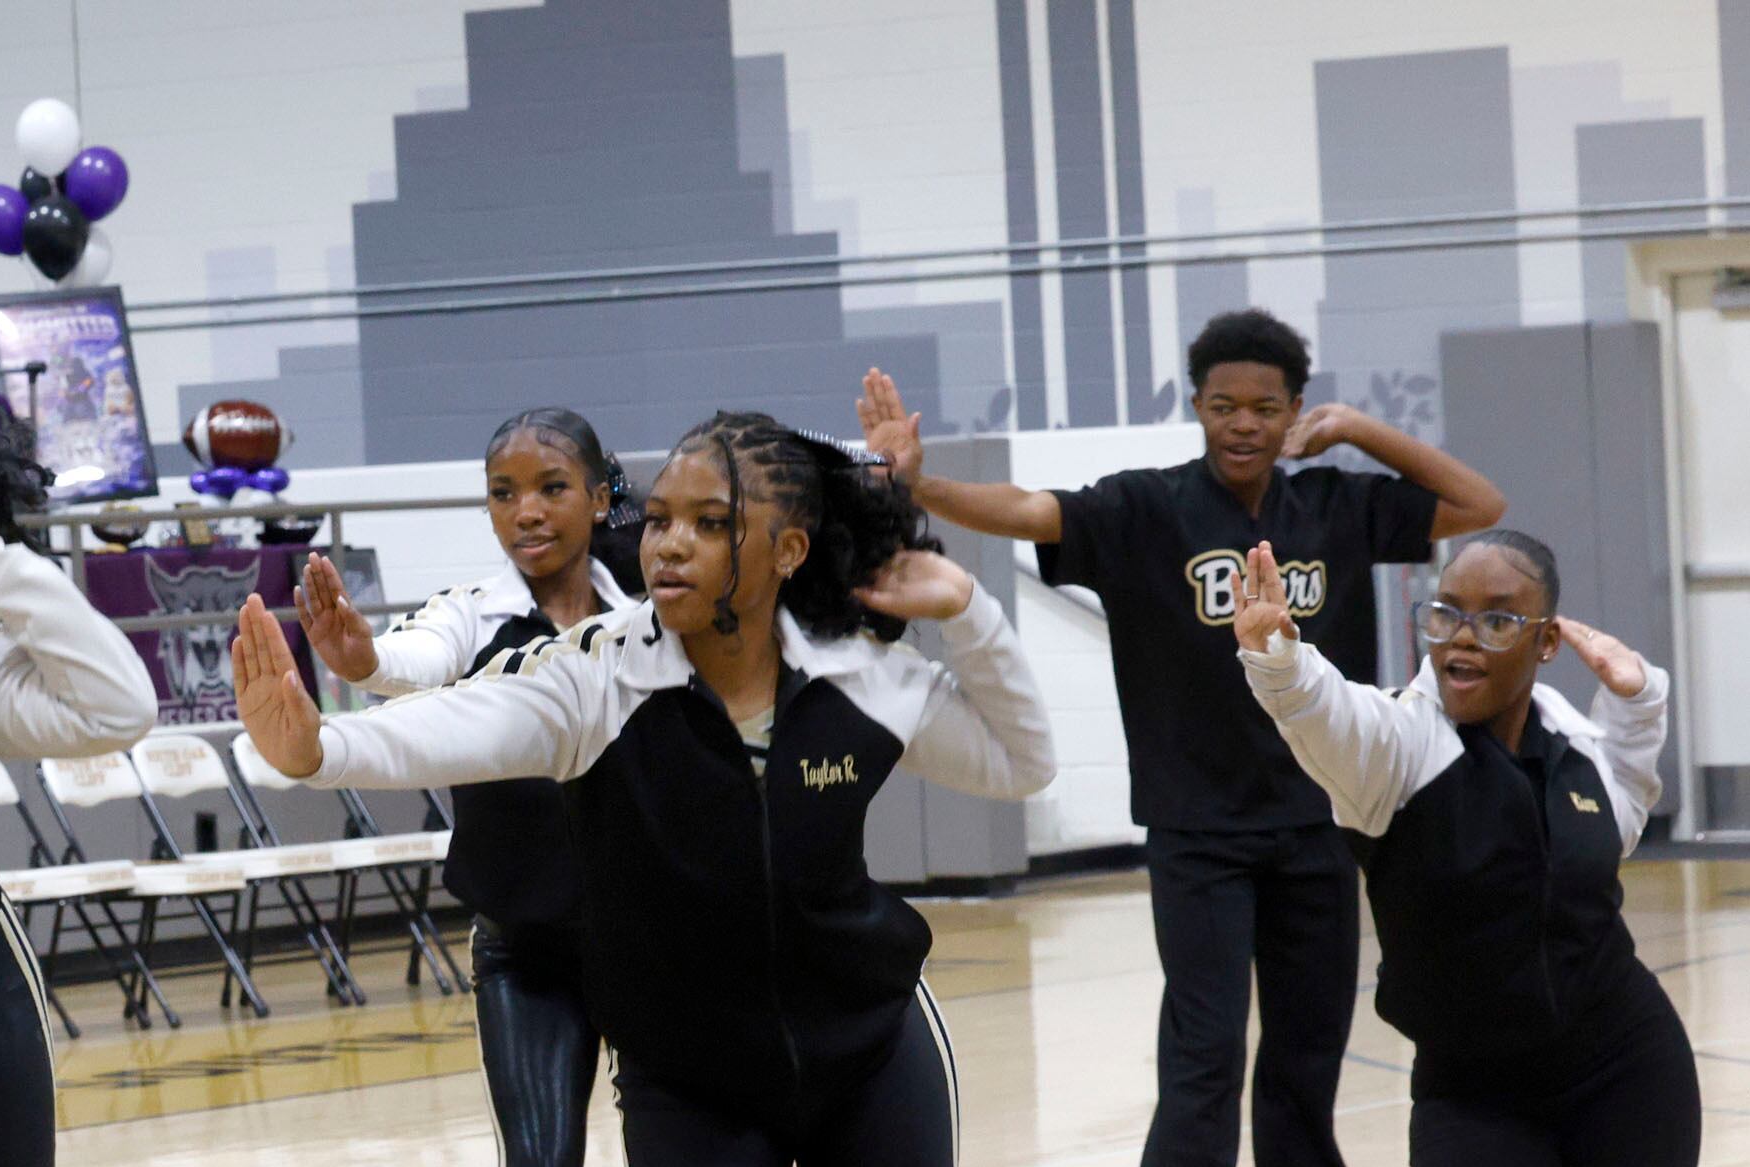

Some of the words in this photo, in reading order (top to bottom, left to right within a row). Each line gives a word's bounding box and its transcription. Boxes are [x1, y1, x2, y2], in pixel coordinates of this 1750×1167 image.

[1188, 553, 1326, 621] Brs
[800, 757, 843, 792] Taylor
[843, 754, 858, 784] R.
